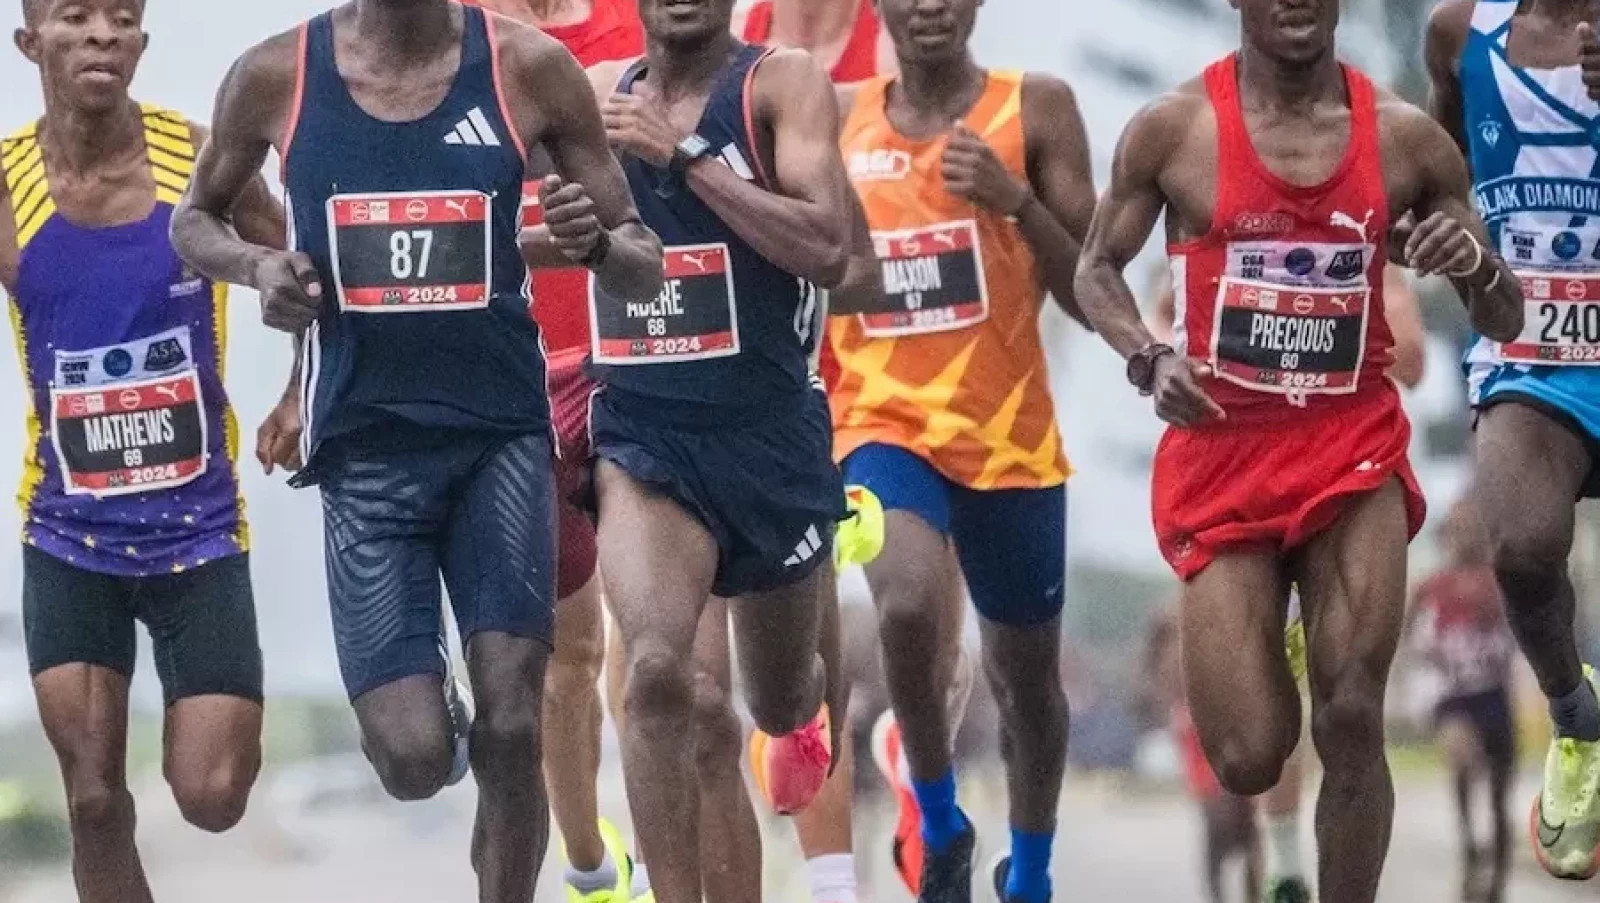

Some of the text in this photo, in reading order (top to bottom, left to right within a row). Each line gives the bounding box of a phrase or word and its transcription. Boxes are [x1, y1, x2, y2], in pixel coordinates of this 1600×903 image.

[1525, 183, 1600, 211] DIAMON
[390, 230, 433, 279] 87
[883, 256, 942, 294] MAXON
[408, 287, 457, 303] 2024
[911, 306, 956, 326] 2024
[647, 318, 667, 335] 68
[1250, 313, 1337, 352] PRECIOUS
[653, 337, 701, 354] 2024
[1280, 353, 1299, 370] 60
[1281, 371, 1327, 388] 2024
[84, 408, 174, 452] MATHEWS
[123, 449, 143, 467] 69
[130, 464, 178, 484] 2024
